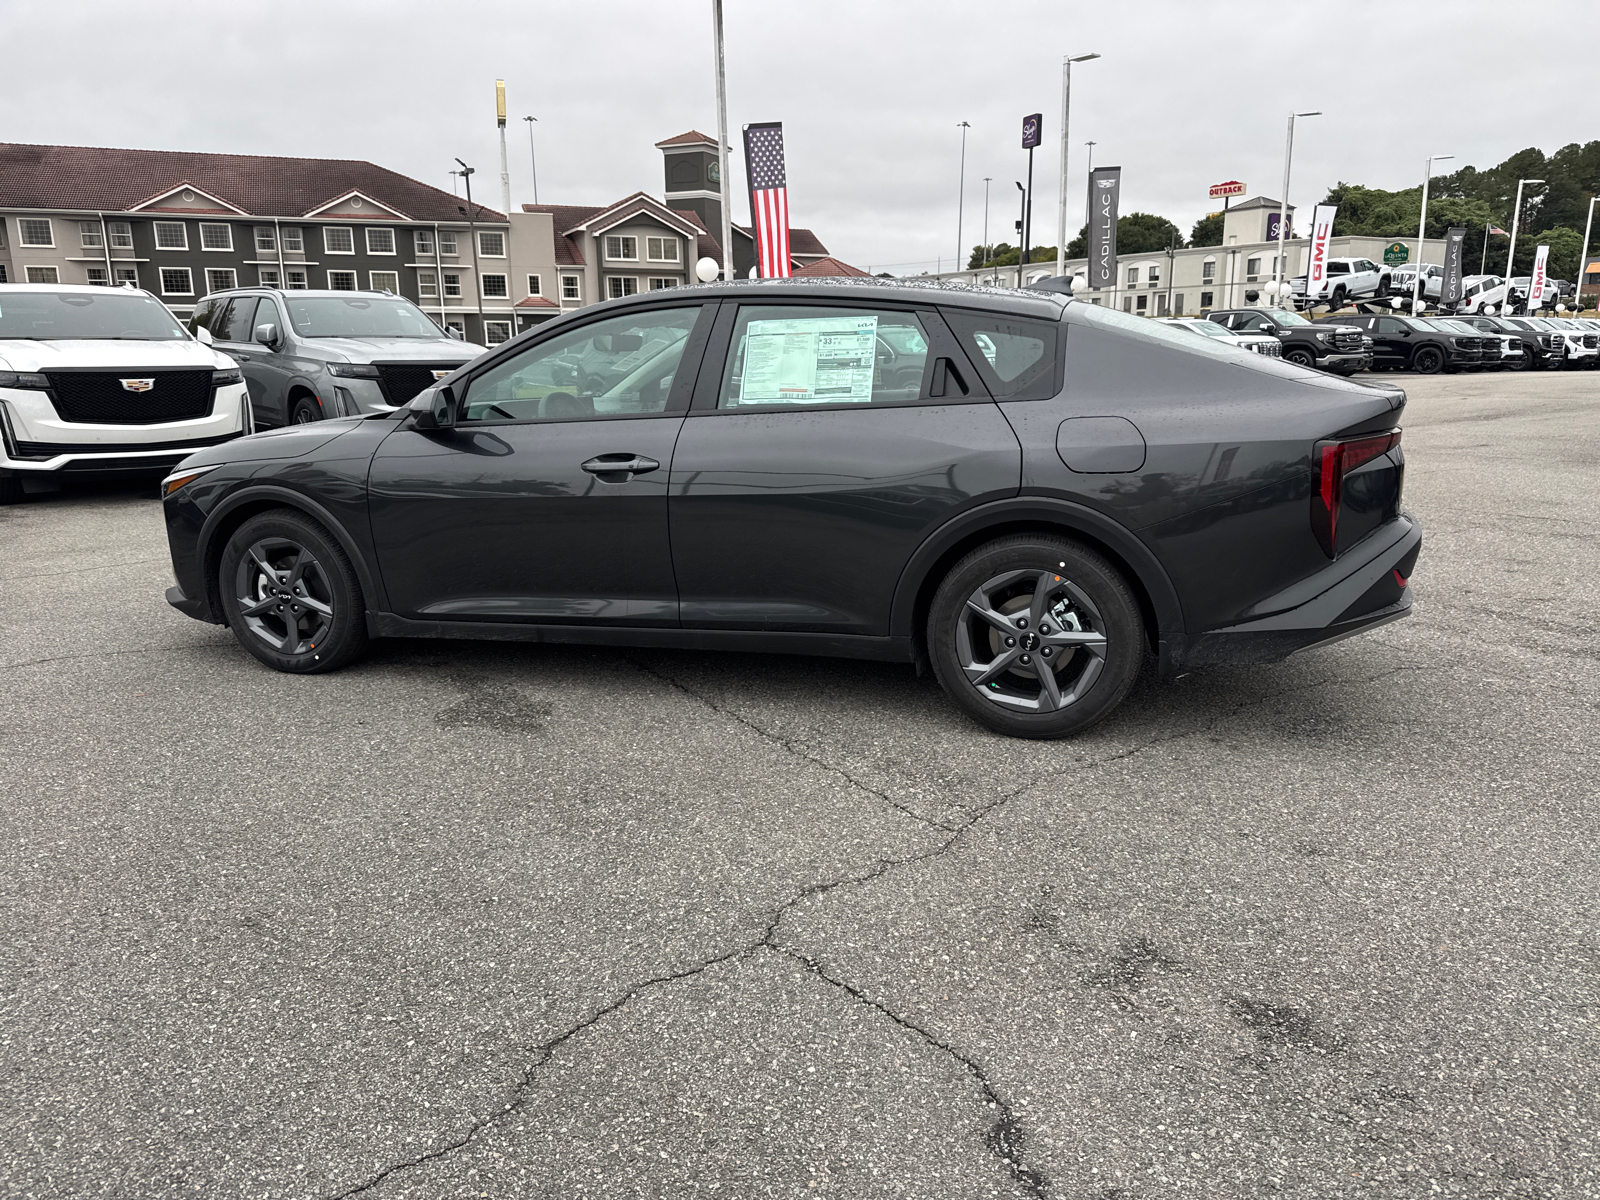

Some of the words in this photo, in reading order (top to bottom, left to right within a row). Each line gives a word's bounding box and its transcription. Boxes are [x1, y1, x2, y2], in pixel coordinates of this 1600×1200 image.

[1209, 185, 1243, 196] OUTBACK
[1101, 194, 1111, 280] CADILLAC
[1312, 223, 1329, 281] GMC
[1449, 245, 1458, 299] CADILLAC
[1532, 257, 1545, 300] GMC
[822, 337, 833, 345] 33
